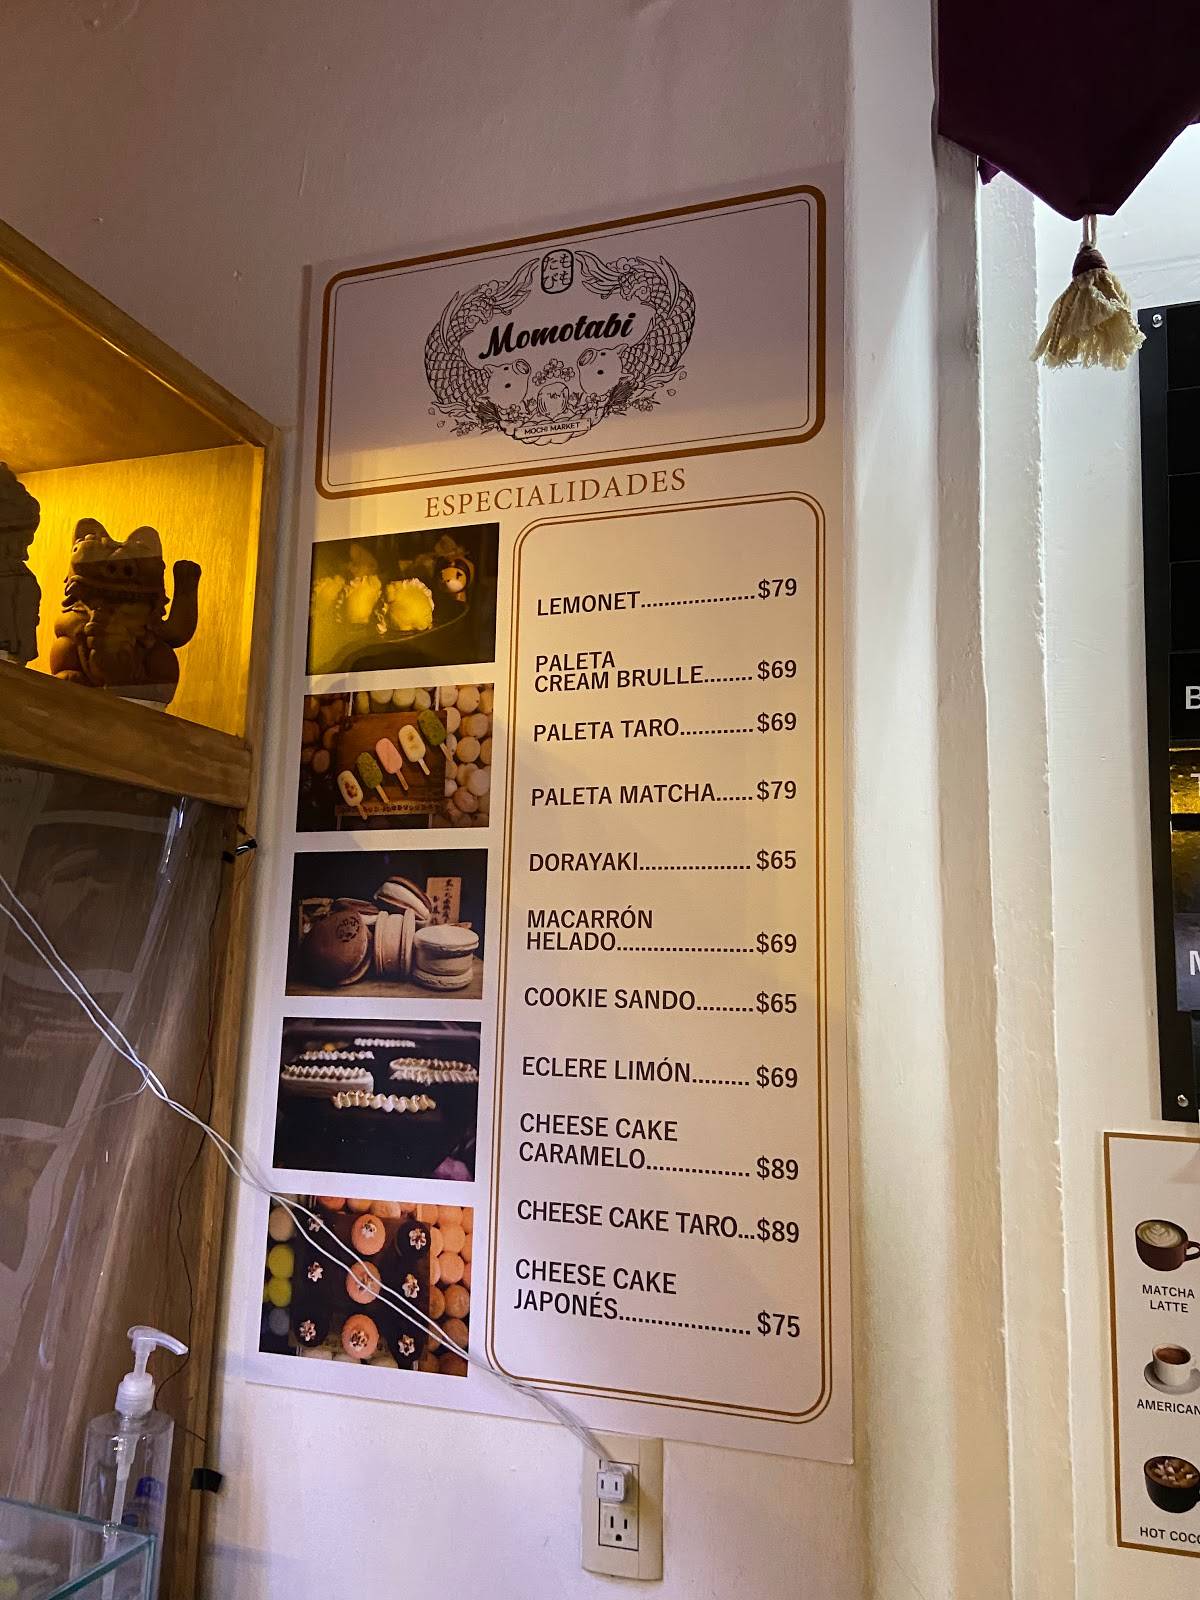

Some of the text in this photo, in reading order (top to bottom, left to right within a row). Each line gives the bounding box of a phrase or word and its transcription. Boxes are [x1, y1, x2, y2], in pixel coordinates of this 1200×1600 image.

[478, 312, 636, 360] Momotabi
[524, 421, 581, 435] MOCHI MARKET
[424, 467, 687, 519] ESPECIALIDADES
[758, 578, 797, 600] $79
[536, 651, 615, 673] PALETA
[534, 671, 609, 693] CREAM
[757, 660, 797, 681] $69
[533, 721, 614, 742] PALETA
[757, 712, 797, 733] $69
[531, 787, 612, 806] PALETA
[757, 780, 797, 801] $79
[756, 849, 797, 871] $65
[527, 905, 653, 928] MACARRÓN
[756, 932, 797, 954] $69
[524, 987, 608, 1008] COOKIE
[756, 991, 797, 1014] $65
[522, 1056, 607, 1079] ECLERE
[756, 1065, 798, 1088] $69
[520, 1113, 678, 1141] CHEESE CAKE
[757, 1156, 799, 1180] $89
[517, 1200, 602, 1226] CHEESE
[609, 1207, 669, 1232] CAKE
[757, 1217, 800, 1243] $89
[515, 1259, 677, 1294] CHEESE CAKE
[1142, 1284, 1195, 1299] MATCHA
[1150, 1299, 1189, 1313] LATTE
[757, 1310, 801, 1337] $75
[1140, 1526, 1166, 1540] HOT
